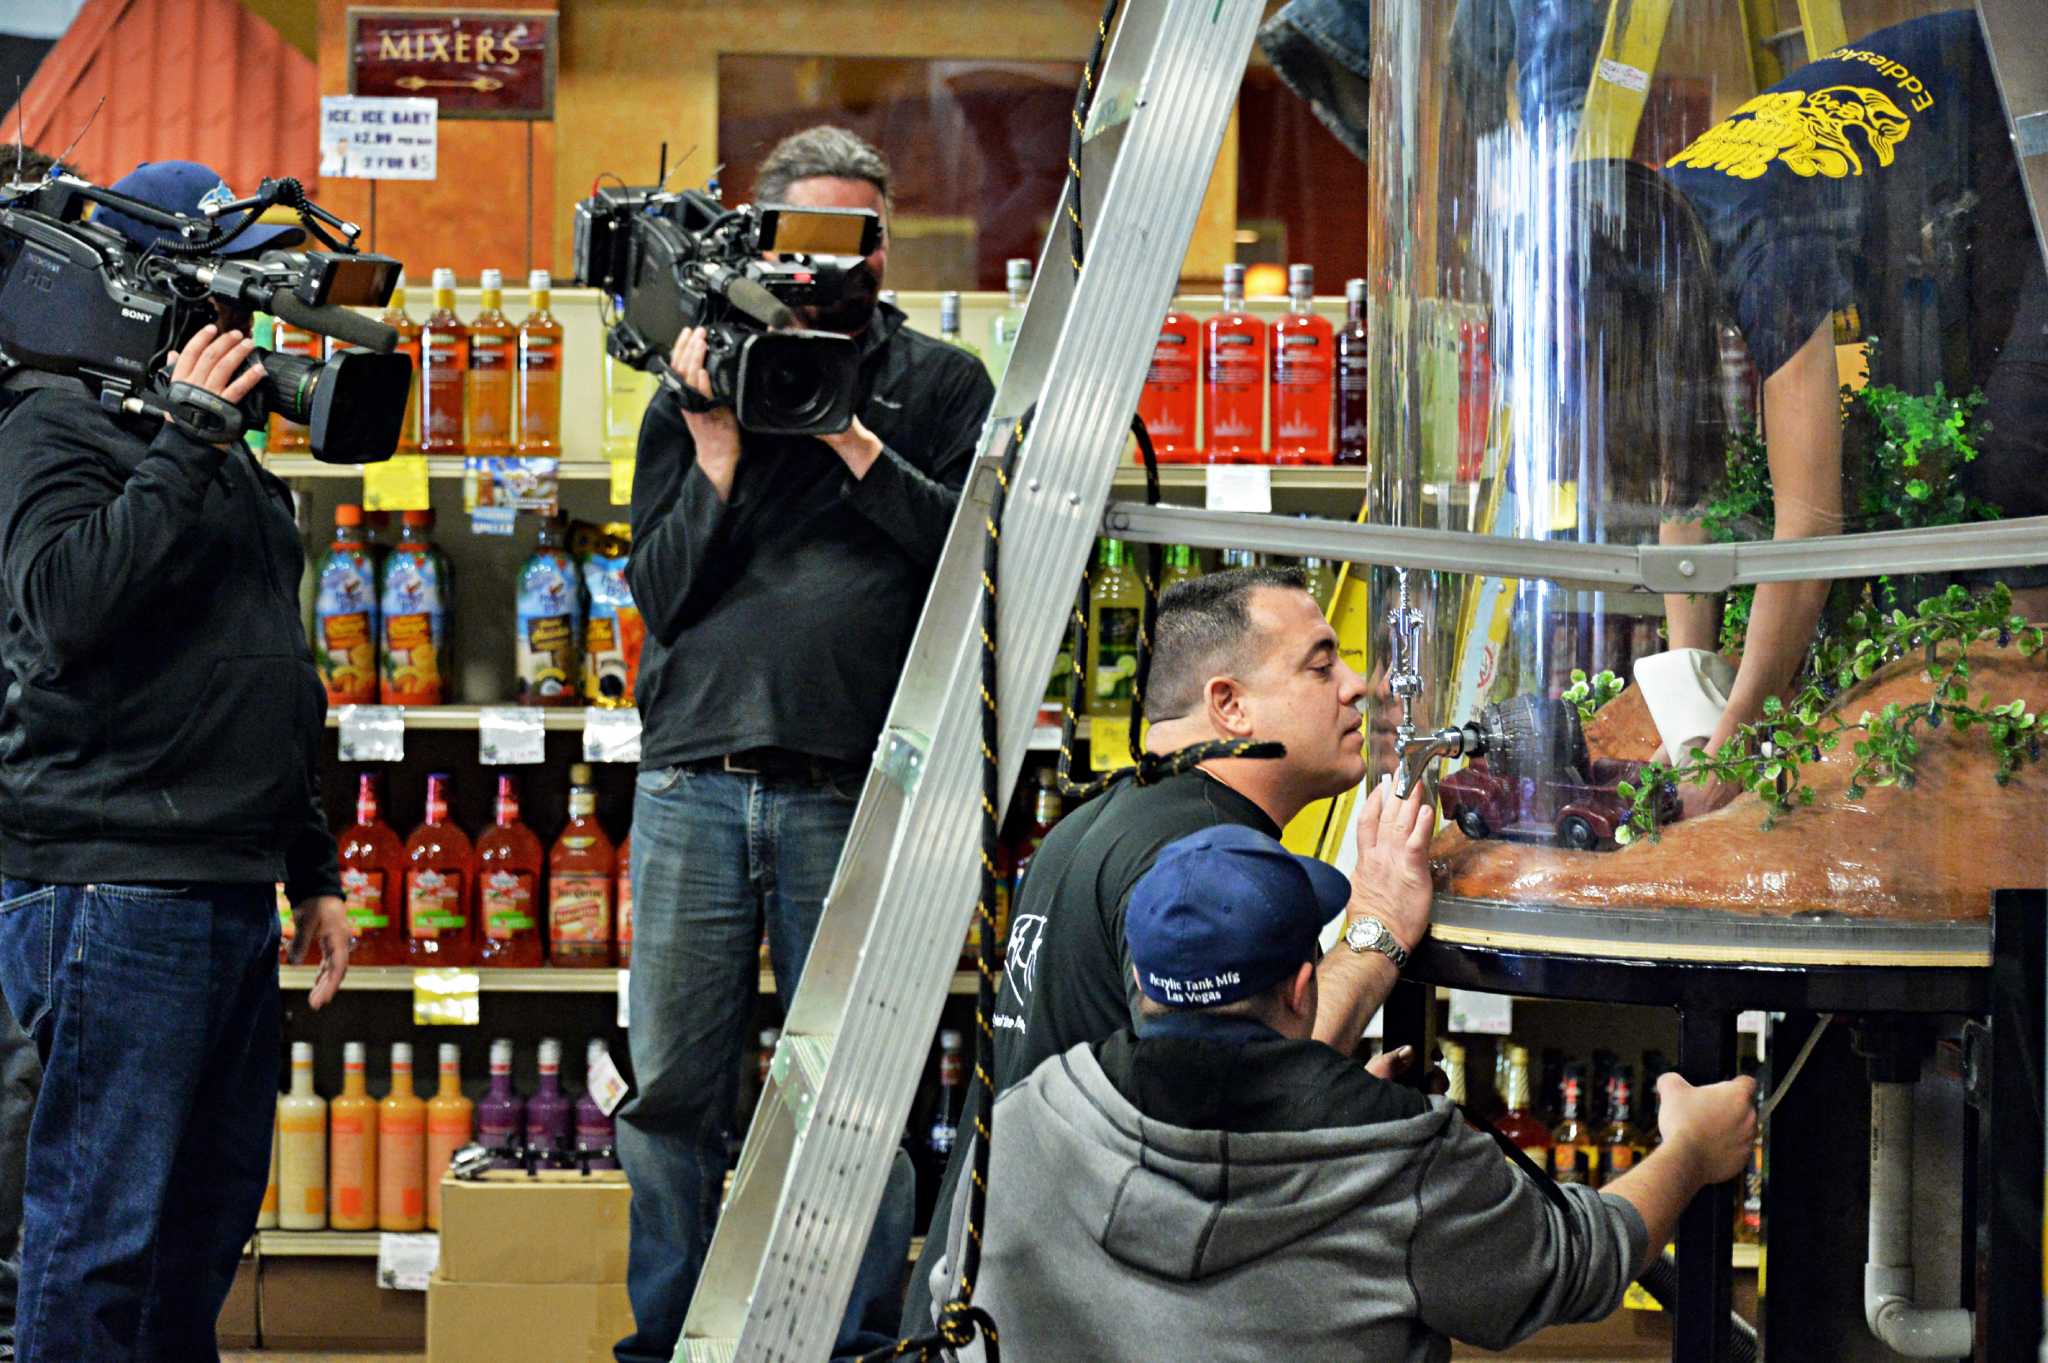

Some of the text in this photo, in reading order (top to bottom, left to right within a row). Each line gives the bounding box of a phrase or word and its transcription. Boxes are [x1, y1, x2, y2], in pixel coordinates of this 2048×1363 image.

[378, 31, 522, 65] MIXERS
[361, 109, 384, 124] ICE
[392, 111, 431, 124] BABY
[121, 307, 152, 324] SONY
[1184, 977, 1214, 992] Tank
[1215, 971, 1241, 988] Mfg
[1166, 988, 1222, 1005] Las Vegas
